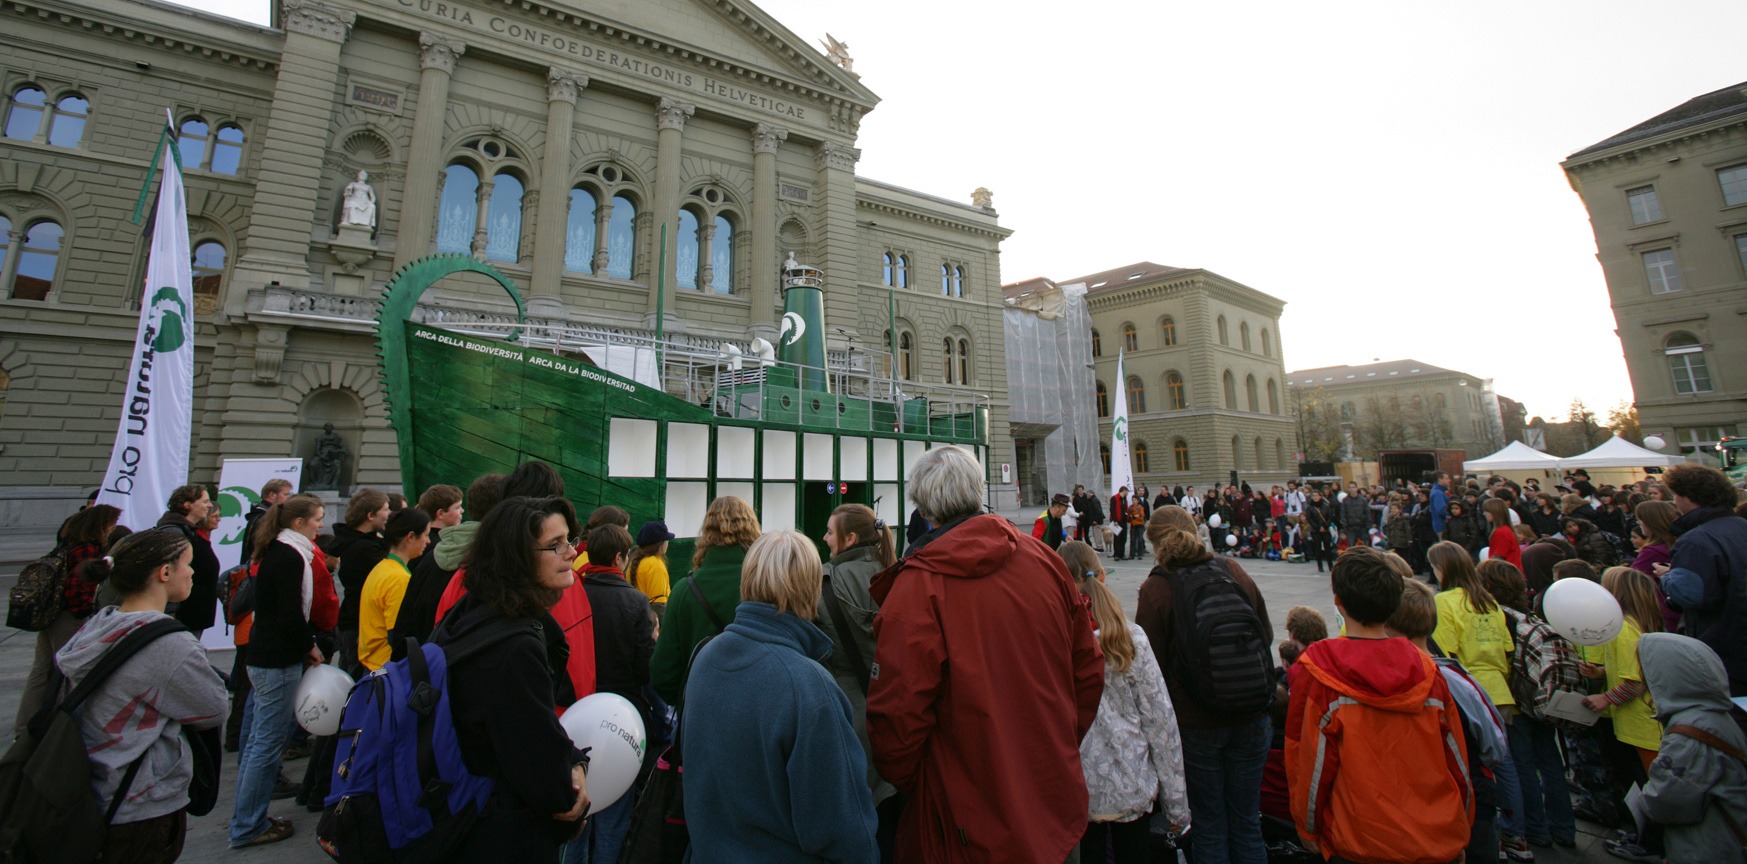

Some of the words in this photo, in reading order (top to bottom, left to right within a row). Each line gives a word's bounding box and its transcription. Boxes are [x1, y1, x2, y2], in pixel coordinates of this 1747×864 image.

[490, 17, 692, 87] CONFOEDERATIONIS
[704, 78, 804, 119] HELVETICAE
[415, 329, 437, 342] ARCA
[438, 335, 464, 348] DELLA
[465, 342, 523, 362] BIODIVERSITÀ
[529, 356, 553, 369] ARCA
[555, 362, 567, 372] DA
[569, 365, 579, 376] LA
[581, 369, 636, 393] BIODIVERSITAD
[599, 719, 617, 733] pro
[618, 728, 641, 758] natura
